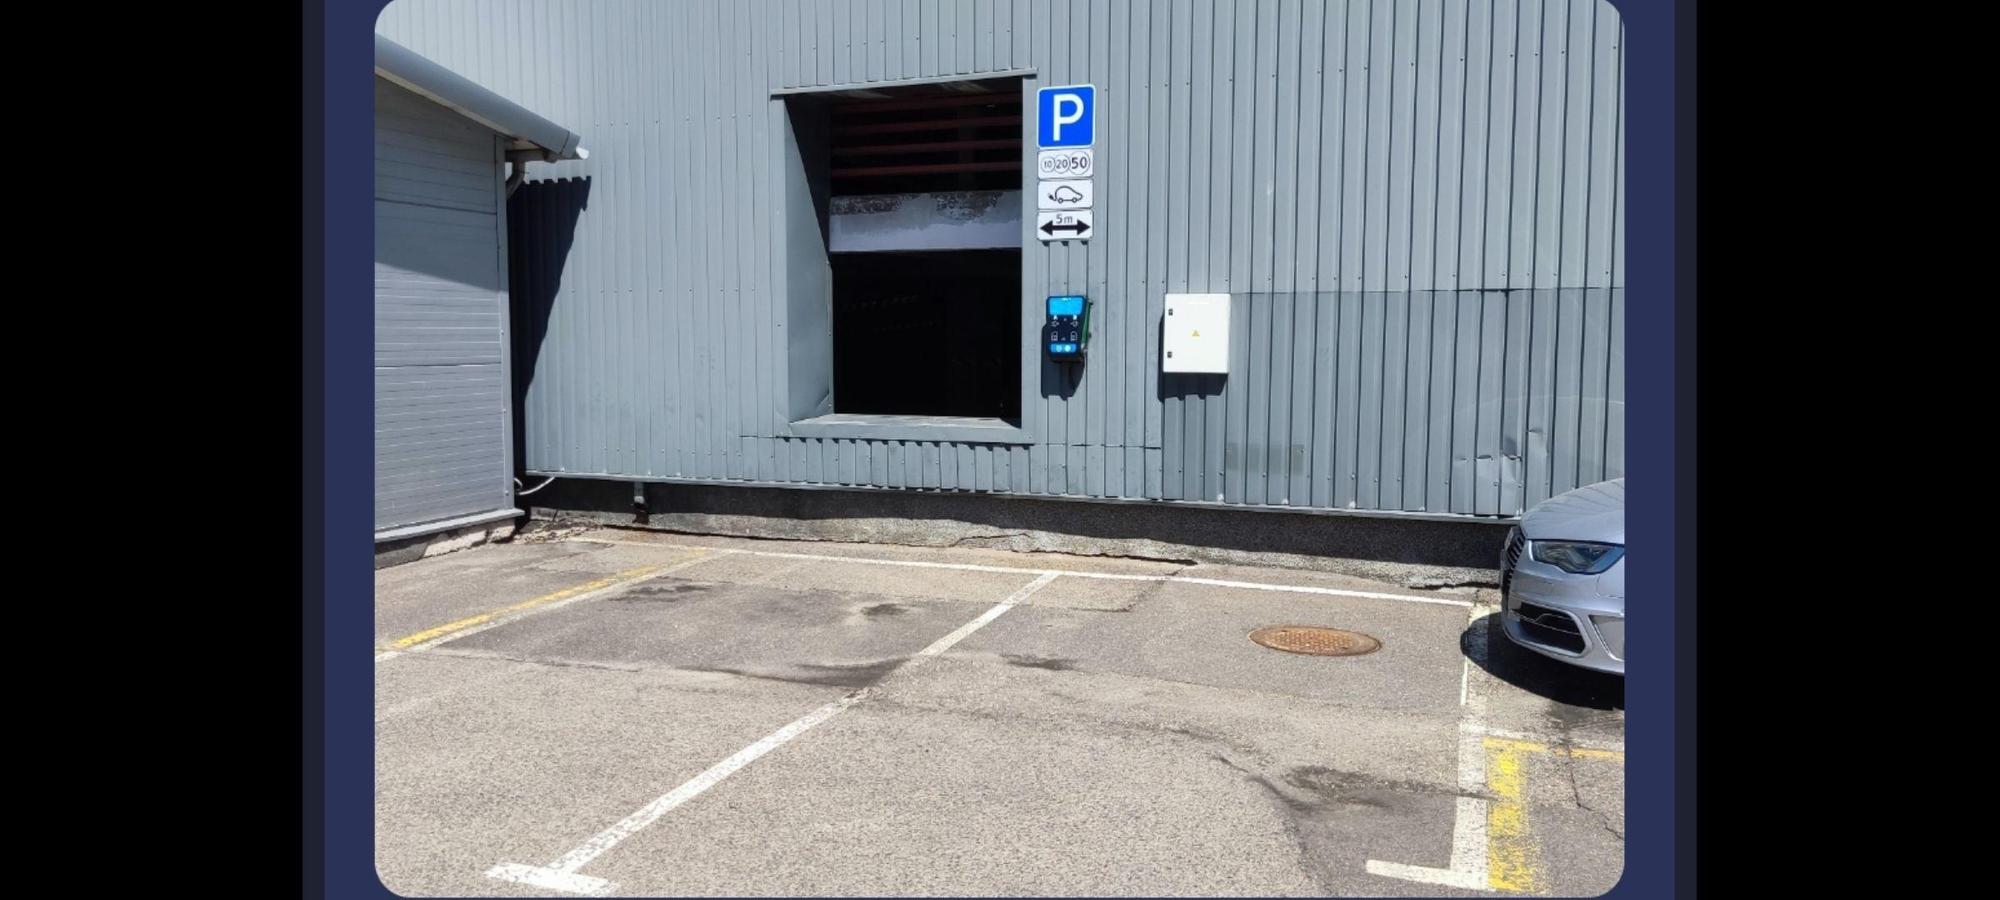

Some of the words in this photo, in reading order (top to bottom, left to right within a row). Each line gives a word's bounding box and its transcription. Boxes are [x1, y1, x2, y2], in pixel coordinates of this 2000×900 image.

[1053, 93, 1084, 142] P
[1044, 160, 1053, 169] 10
[1056, 159, 1068, 169] 20
[1071, 157, 1088, 169] 50
